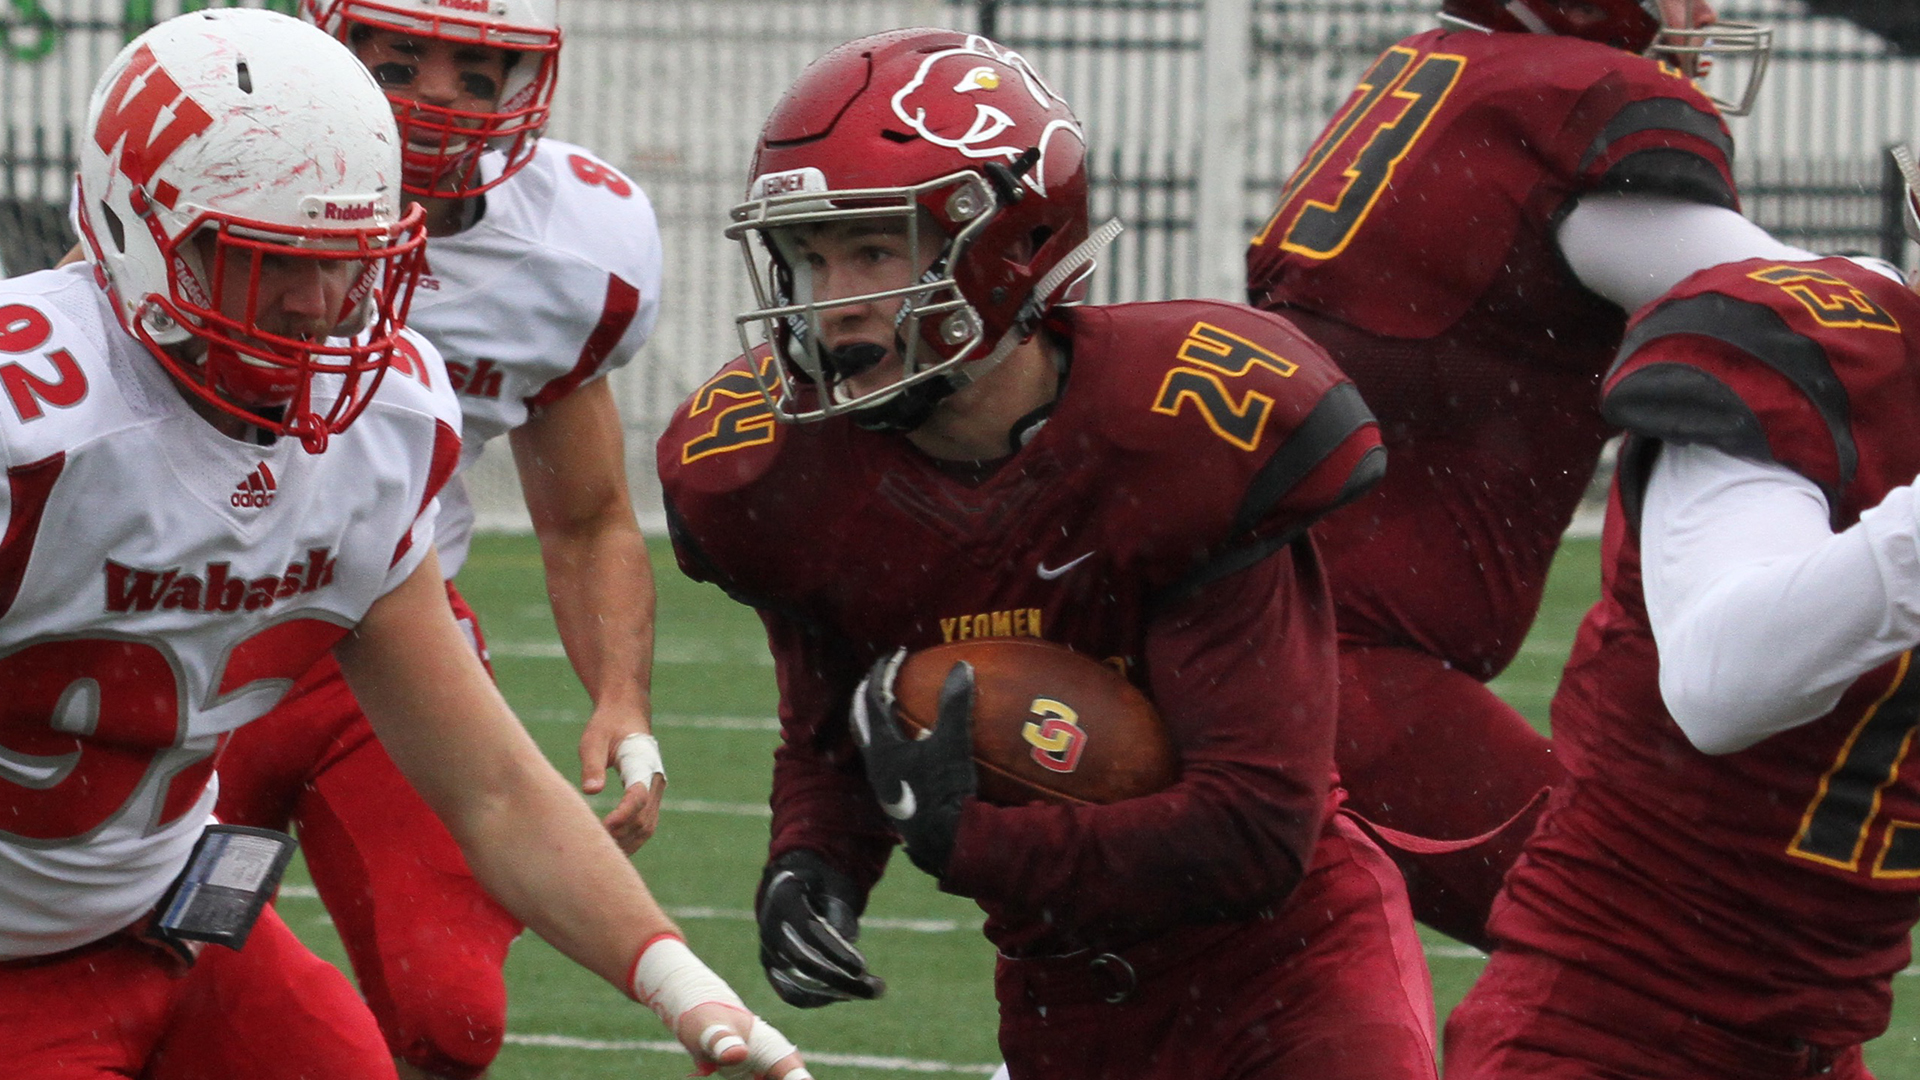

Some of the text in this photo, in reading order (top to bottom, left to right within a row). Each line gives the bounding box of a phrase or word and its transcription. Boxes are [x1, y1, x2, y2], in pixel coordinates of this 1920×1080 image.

[325, 201, 374, 220] Riddell
[1746, 265, 1901, 333] 13
[0, 303, 90, 425] 92
[1151, 321, 1299, 452] 24
[682, 356, 781, 464] 24
[105, 546, 337, 613] Wabash
[939, 608, 1042, 643] YEOMEN
